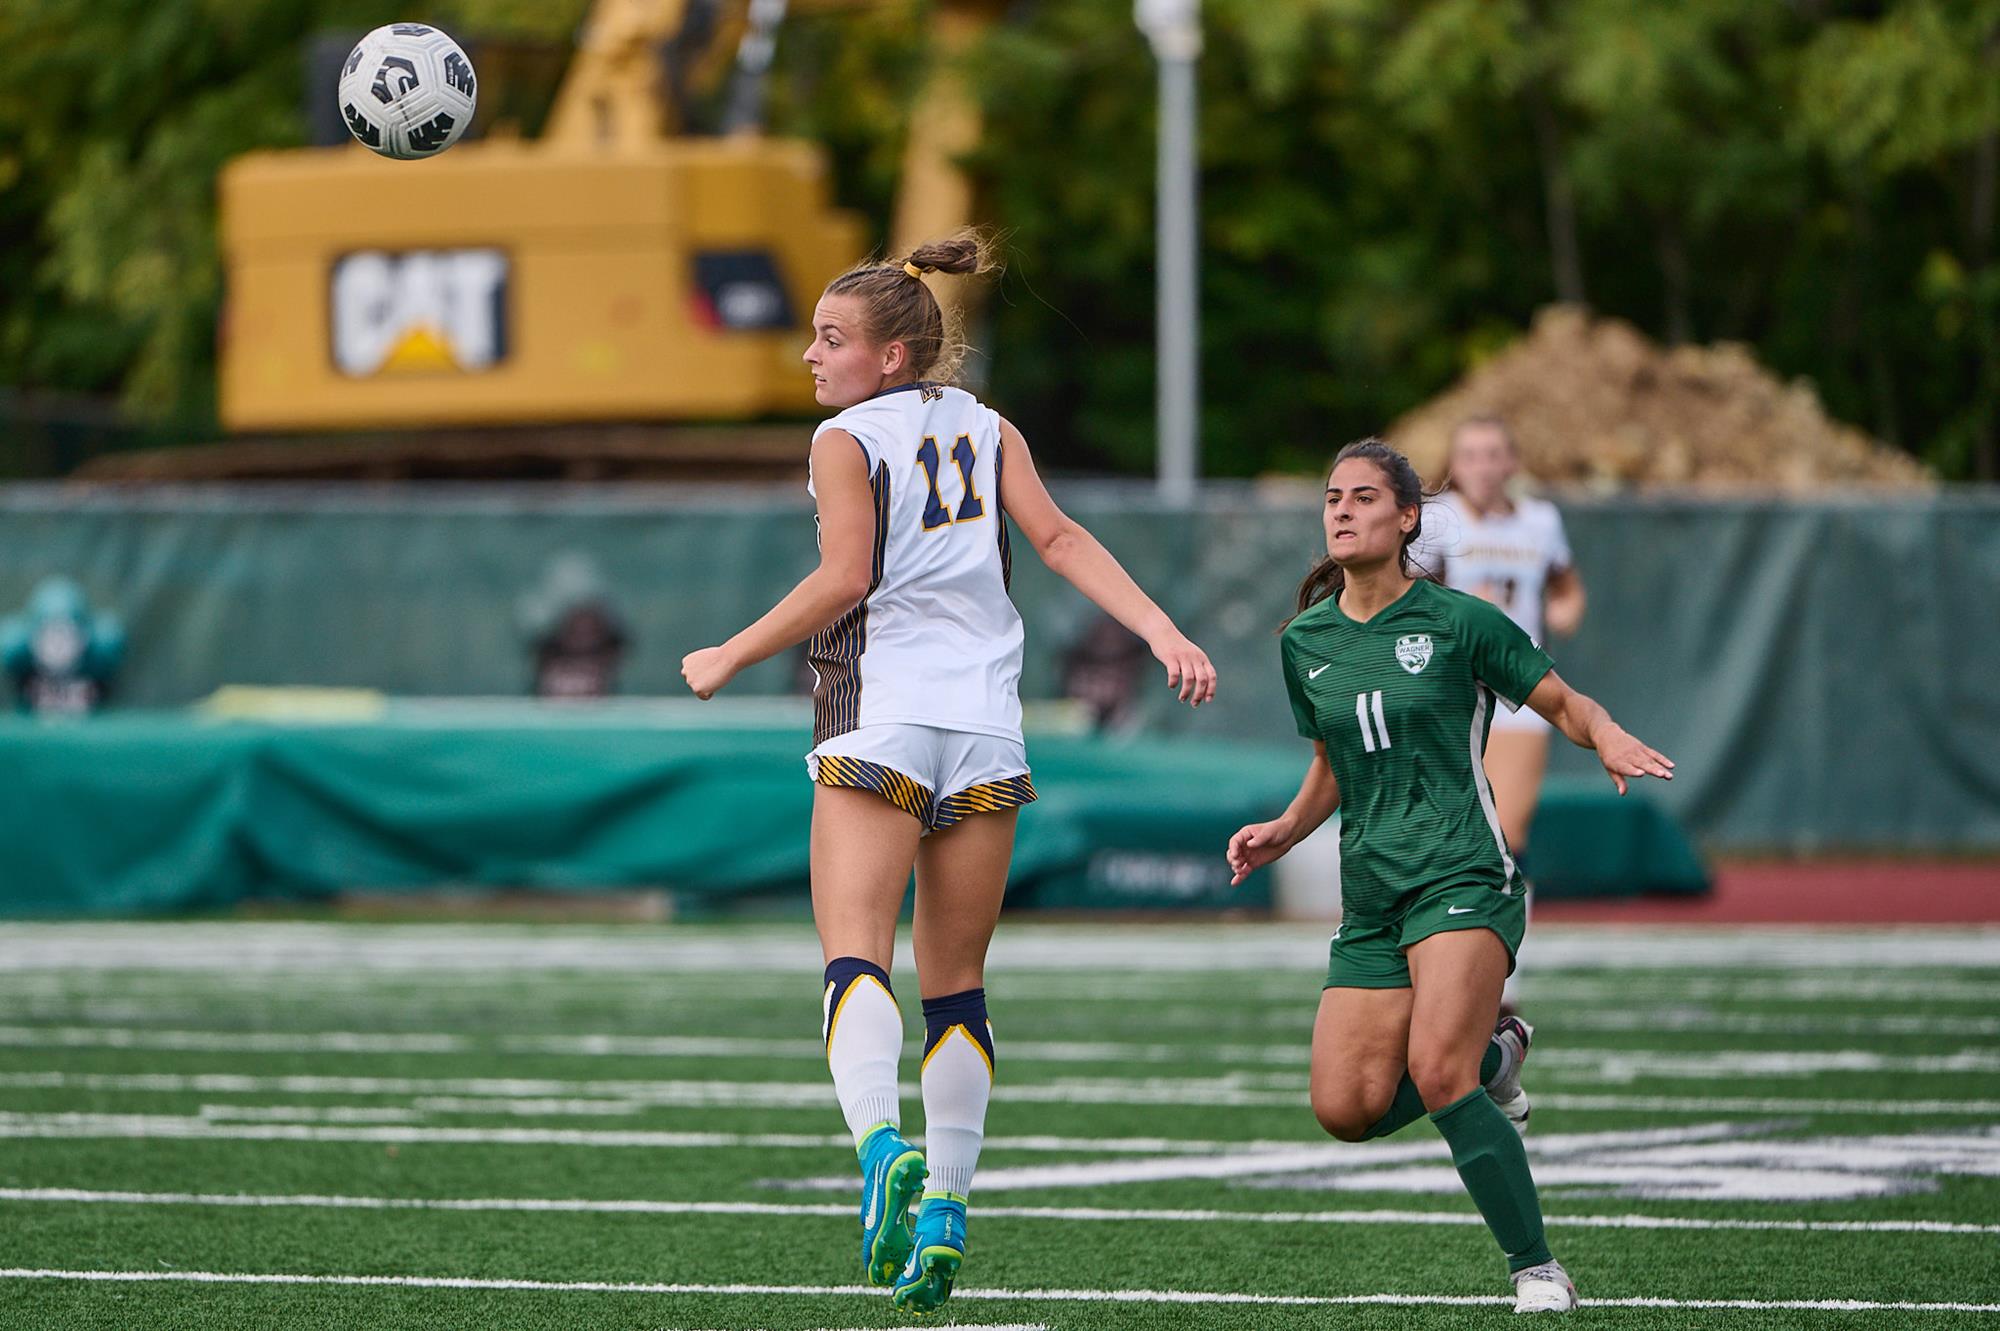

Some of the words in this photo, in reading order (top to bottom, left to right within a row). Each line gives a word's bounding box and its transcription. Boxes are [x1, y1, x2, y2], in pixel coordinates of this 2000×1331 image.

[333, 251, 506, 375] CAT
[916, 433, 985, 531] 11
[1399, 644, 1430, 654] WAGNER
[1356, 690, 1391, 752] 11
